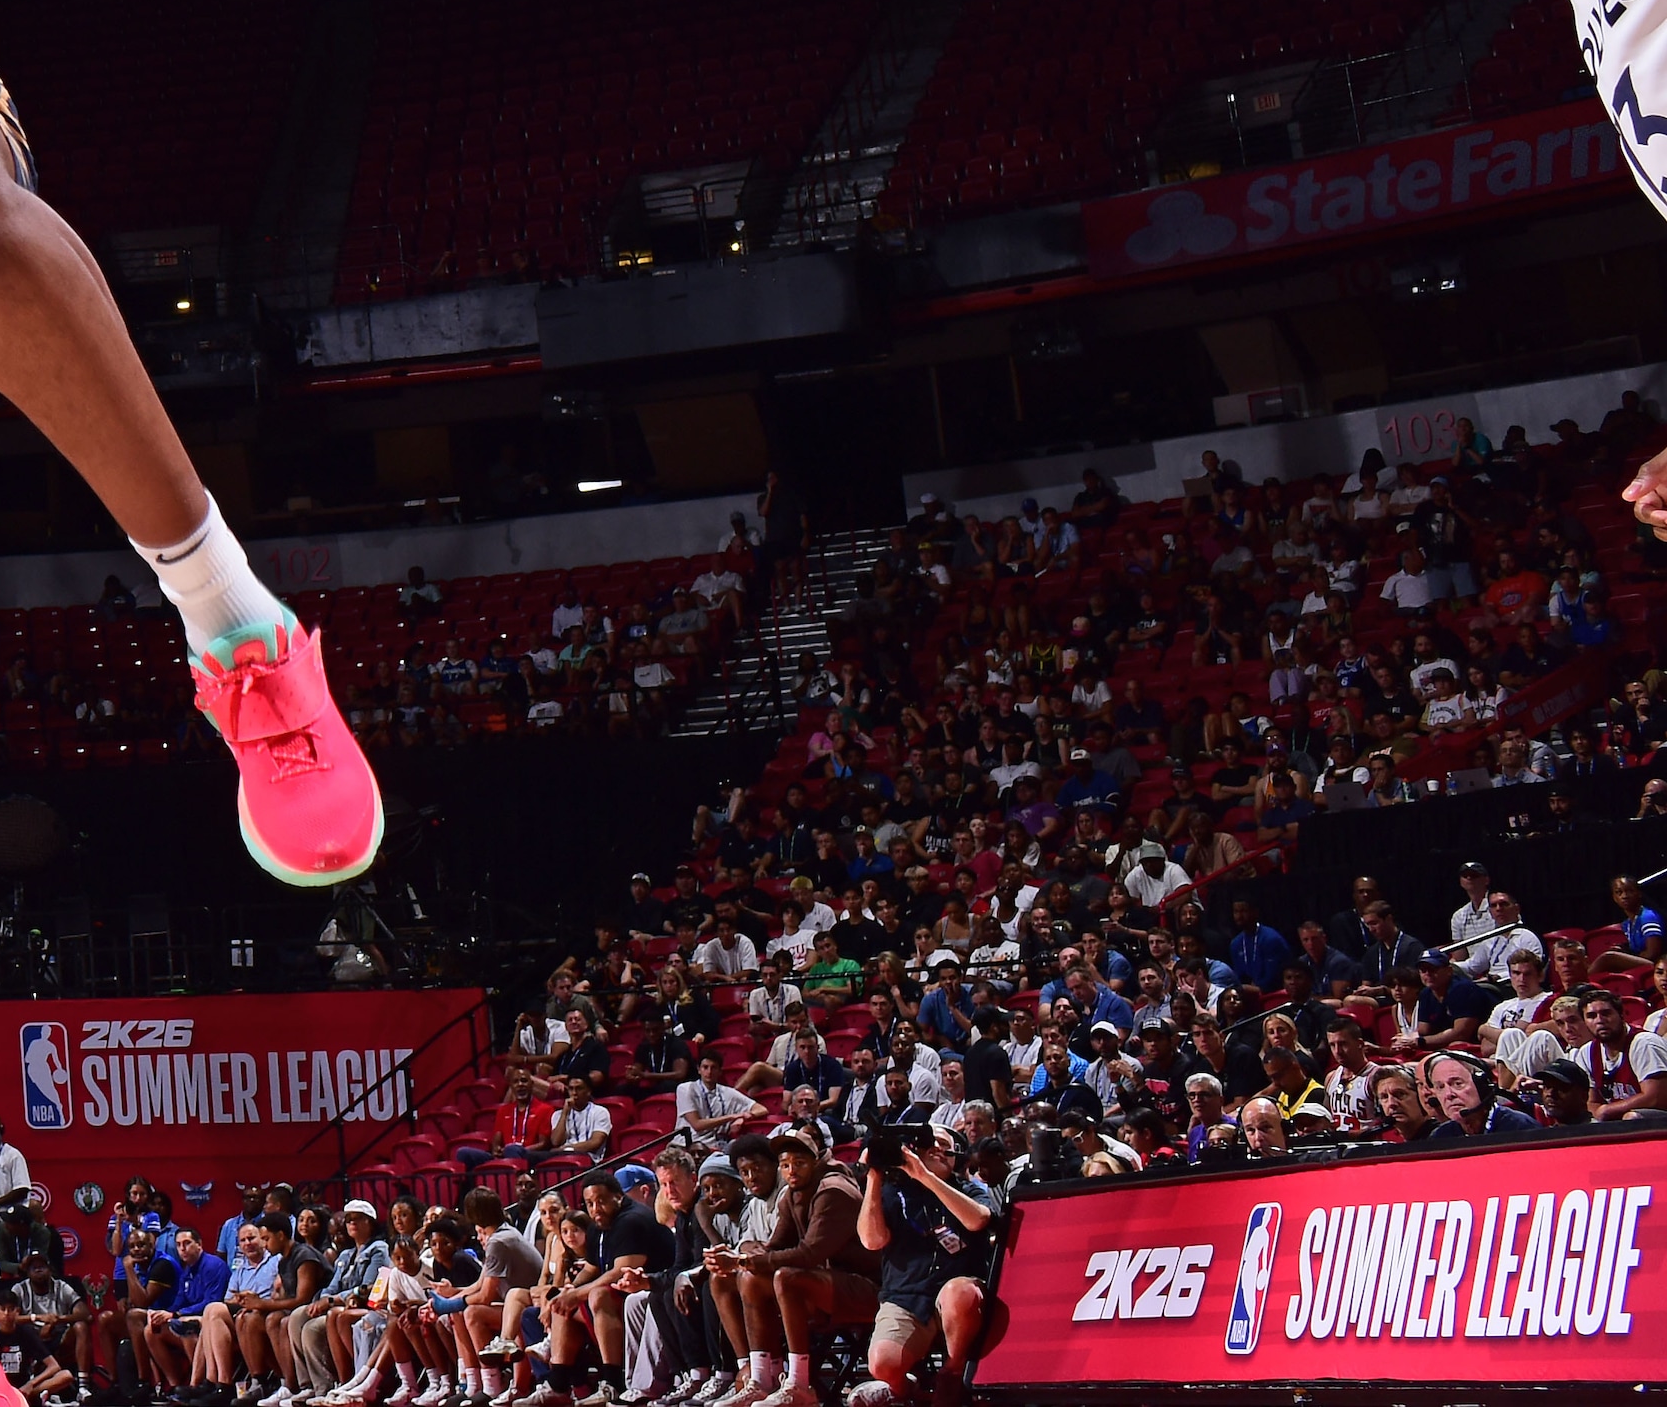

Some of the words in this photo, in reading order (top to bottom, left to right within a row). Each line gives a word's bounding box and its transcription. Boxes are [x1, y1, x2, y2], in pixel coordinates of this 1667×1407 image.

[1245, 148, 1444, 250] State
[1384, 409, 1455, 457] 103
[267, 545, 331, 584] 102
[80, 1019, 195, 1049] 2K26
[82, 1052, 260, 1127] SUMMER
[268, 1049, 416, 1124] LEAGUE
[1328, 1092, 1367, 1122] ULLS
[32, 1105, 56, 1122] NBA
[1072, 1244, 1214, 1322] 2K26
[1286, 1200, 1474, 1340] SUMMER
[1467, 1186, 1652, 1338] LEAGUE
